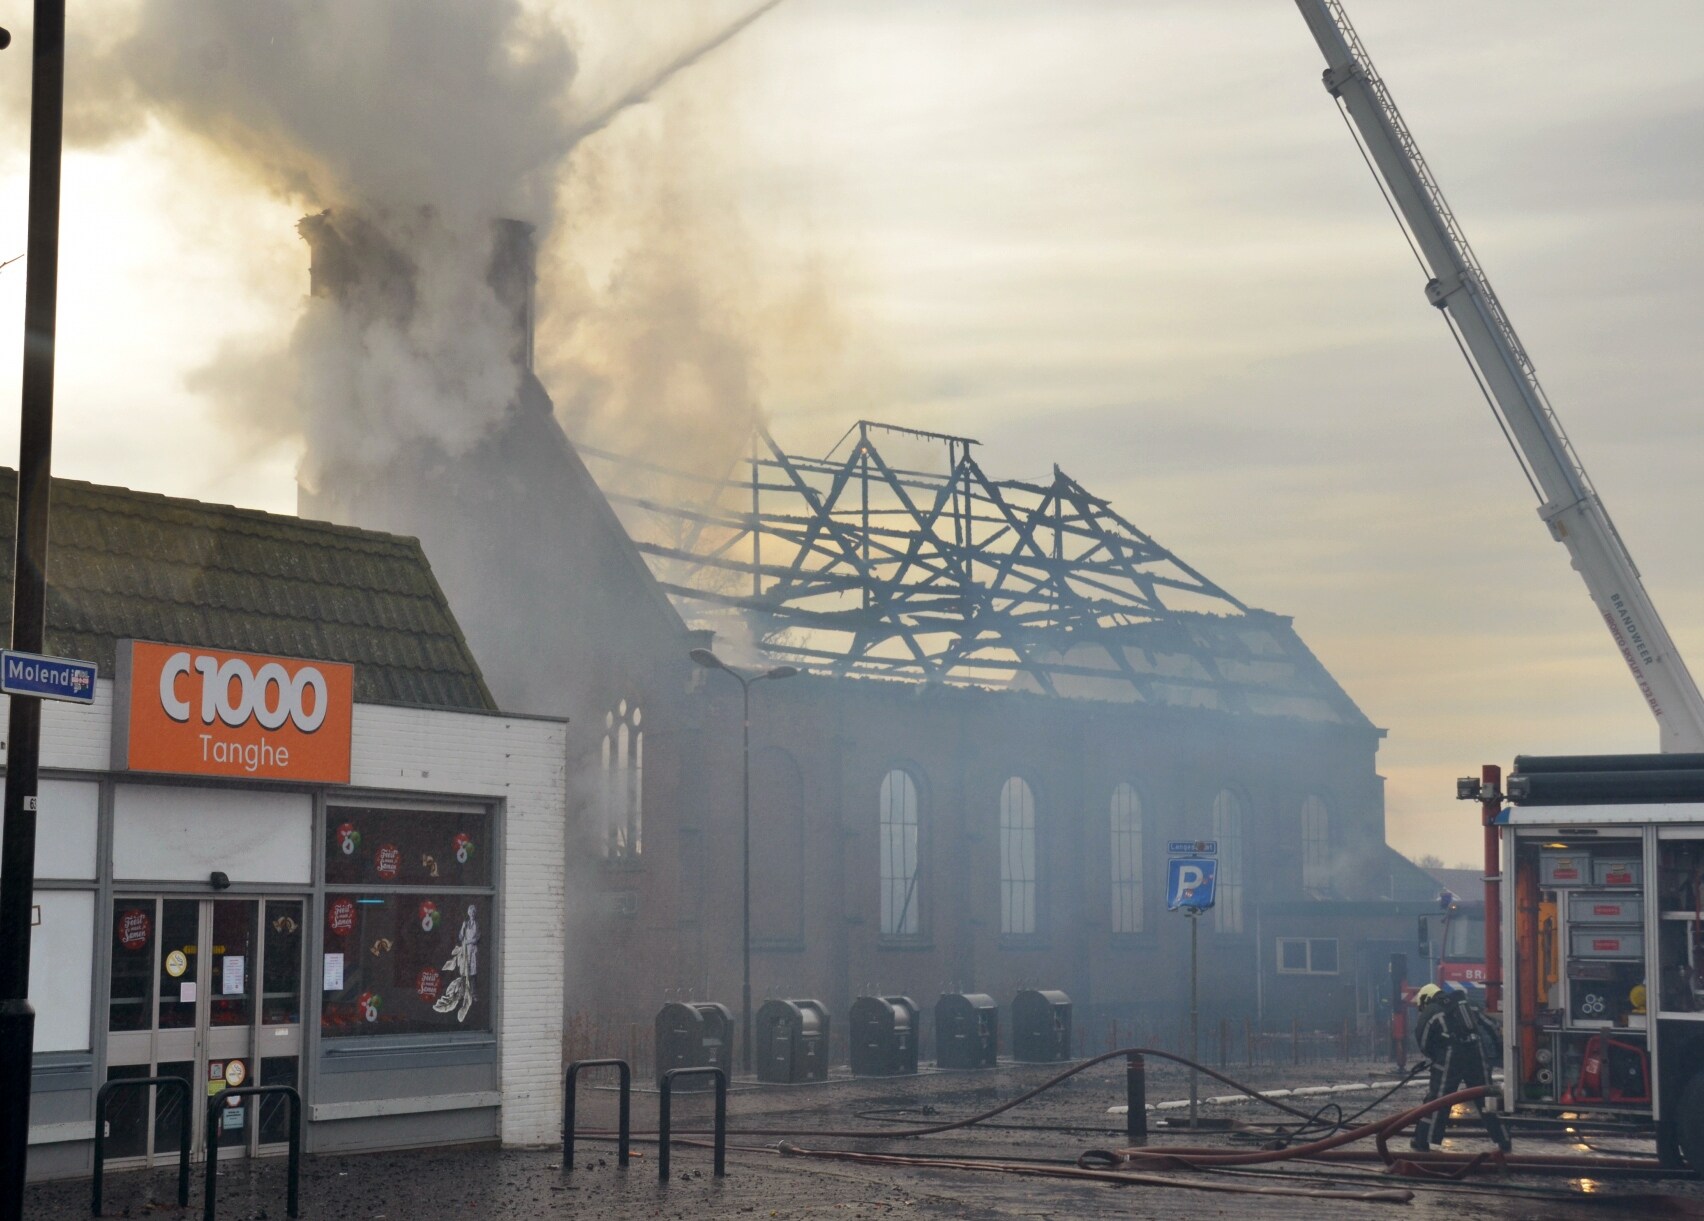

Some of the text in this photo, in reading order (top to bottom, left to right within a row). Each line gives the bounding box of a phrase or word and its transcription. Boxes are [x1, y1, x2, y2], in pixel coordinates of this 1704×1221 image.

[1610, 593, 1653, 666] BRANDWEER
[9, 659, 89, 692] Molendi
[159, 652, 328, 734] C1000
[199, 734, 289, 772] Tanghe
[1173, 865, 1204, 907] P
